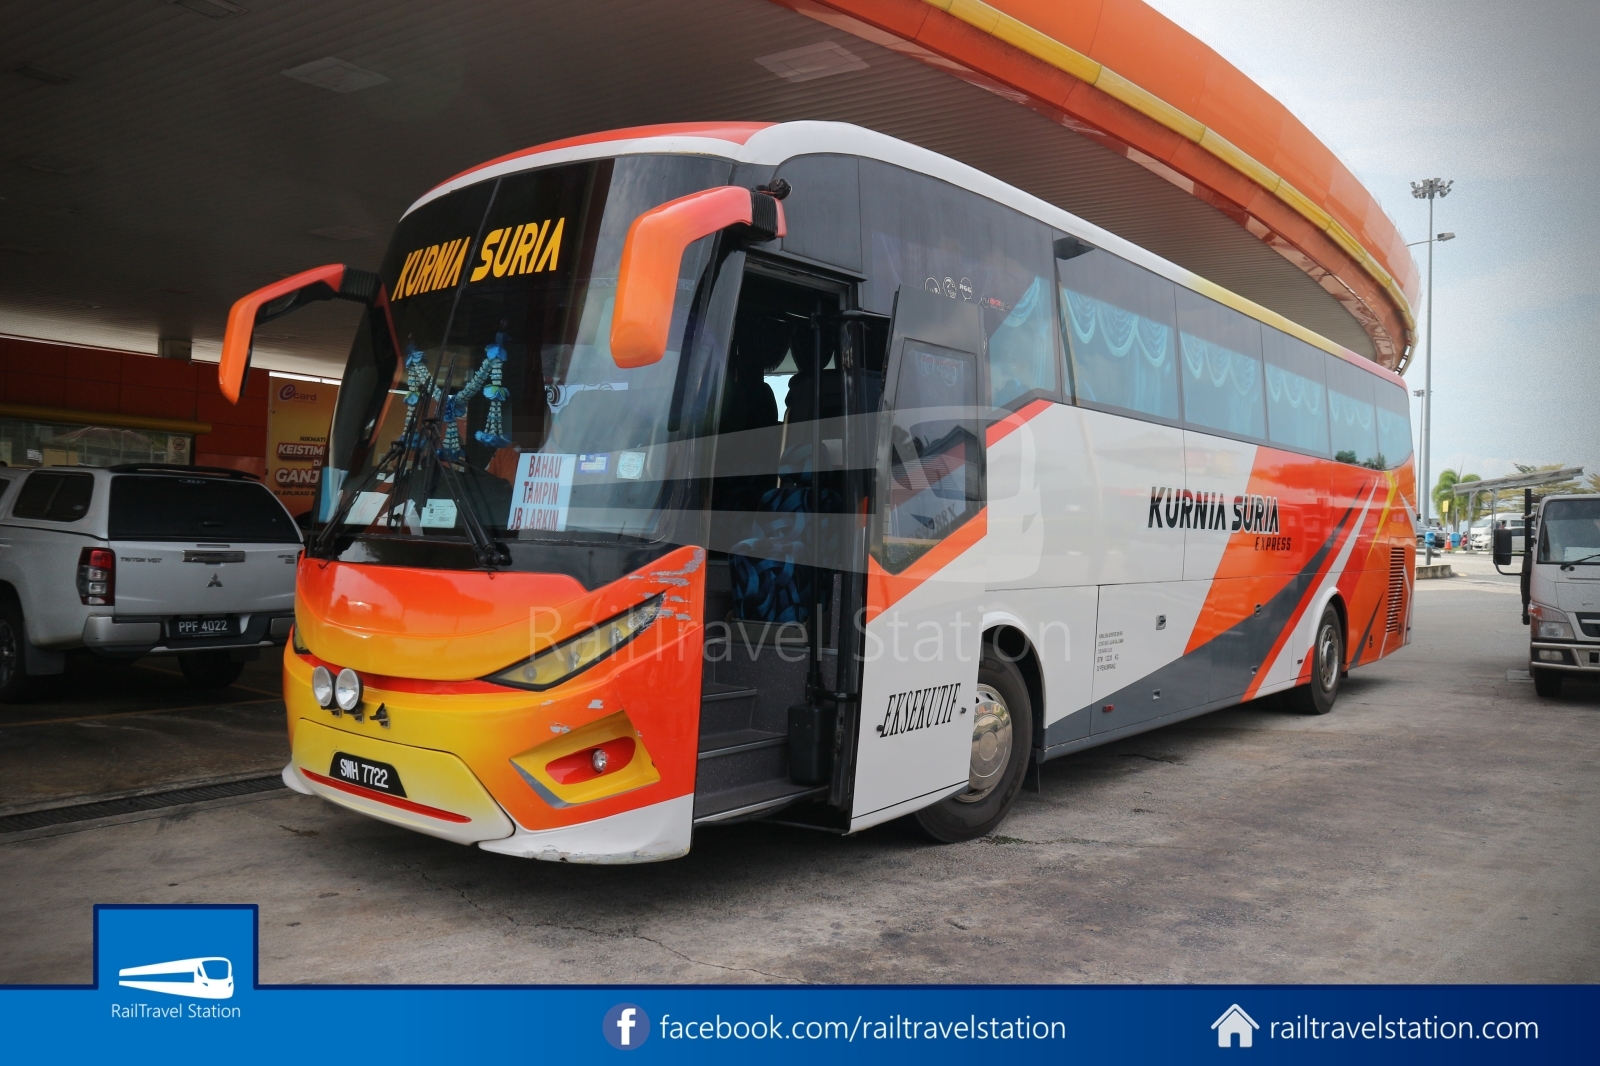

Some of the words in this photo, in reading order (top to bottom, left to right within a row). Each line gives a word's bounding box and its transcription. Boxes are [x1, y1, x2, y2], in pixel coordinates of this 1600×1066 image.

[391, 236, 471, 302] KURNIA
[470, 217, 565, 283] SURIA
[528, 455, 563, 478] BAHAU
[522, 481, 560, 505] TAMPIN
[511, 507, 523, 530] JB
[524, 508, 560, 531] LARKIN
[1148, 486, 1227, 530] KURNIA
[1231, 495, 1279, 533] SURIA
[1254, 537, 1292, 551] EXPRESS
[178, 621, 198, 633] PPF
[201, 620, 228, 632] 4022
[880, 682, 962, 738] EKSEKUTIF
[340, 758, 359, 780] SWH
[361, 763, 389, 788] 7722
